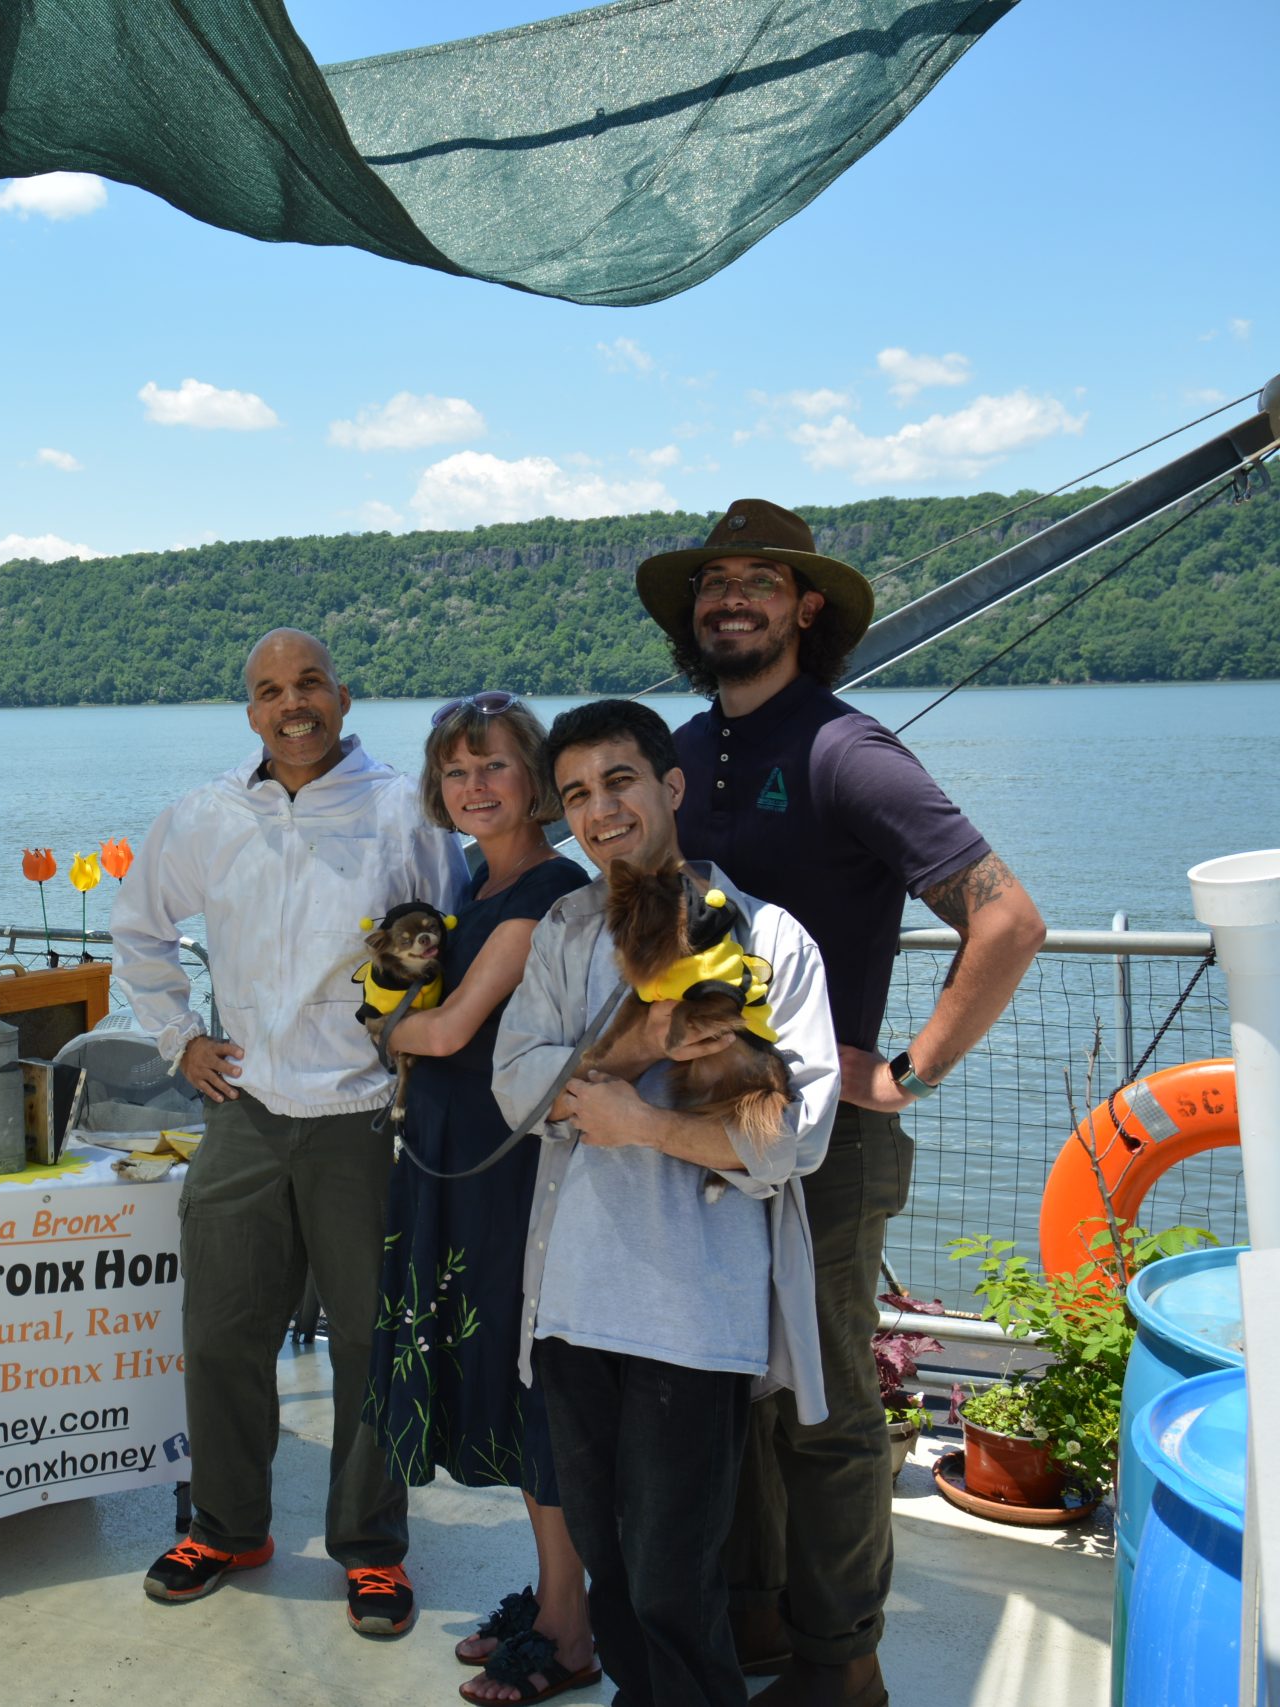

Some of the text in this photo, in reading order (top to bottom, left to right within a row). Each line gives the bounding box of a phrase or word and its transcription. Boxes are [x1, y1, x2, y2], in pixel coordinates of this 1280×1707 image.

[1176, 1088, 1237, 1117] SC
[32, 1204, 136, 1238] Bronx"
[94, 1249, 181, 1290] Hon
[85, 1307, 161, 1337] Raw
[0, 1361, 103, 1393] Bronx
